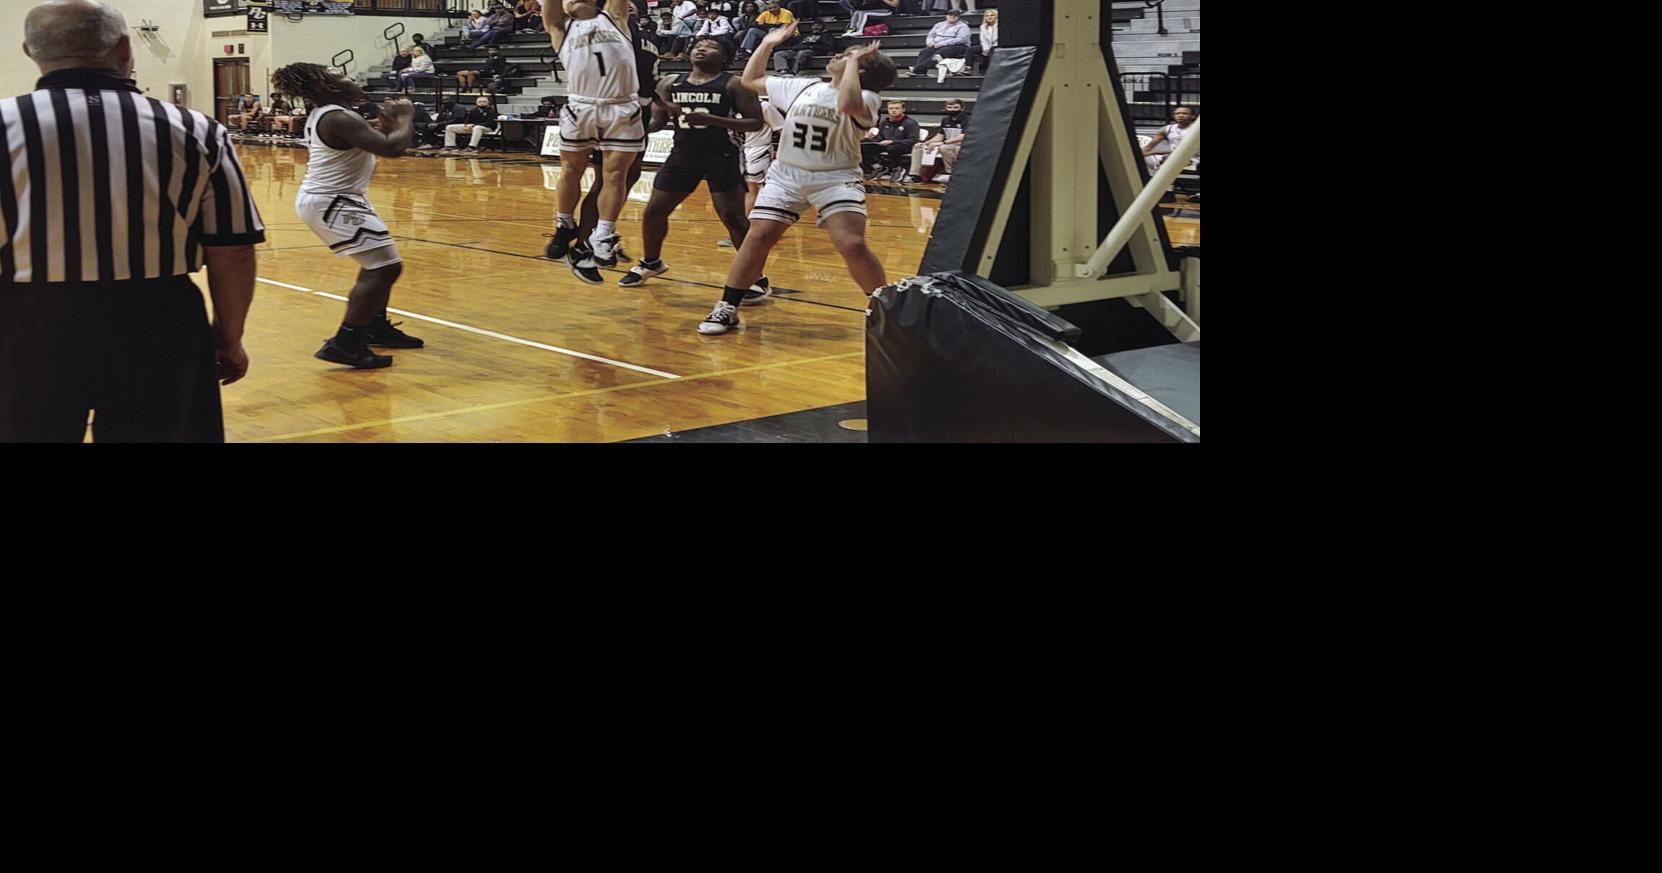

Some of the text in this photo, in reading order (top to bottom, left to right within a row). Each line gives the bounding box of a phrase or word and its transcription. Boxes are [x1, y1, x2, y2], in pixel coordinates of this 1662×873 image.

[592, 52, 606, 76] 1
[672, 92, 722, 104] LINCOLN
[793, 122, 829, 151] 33
